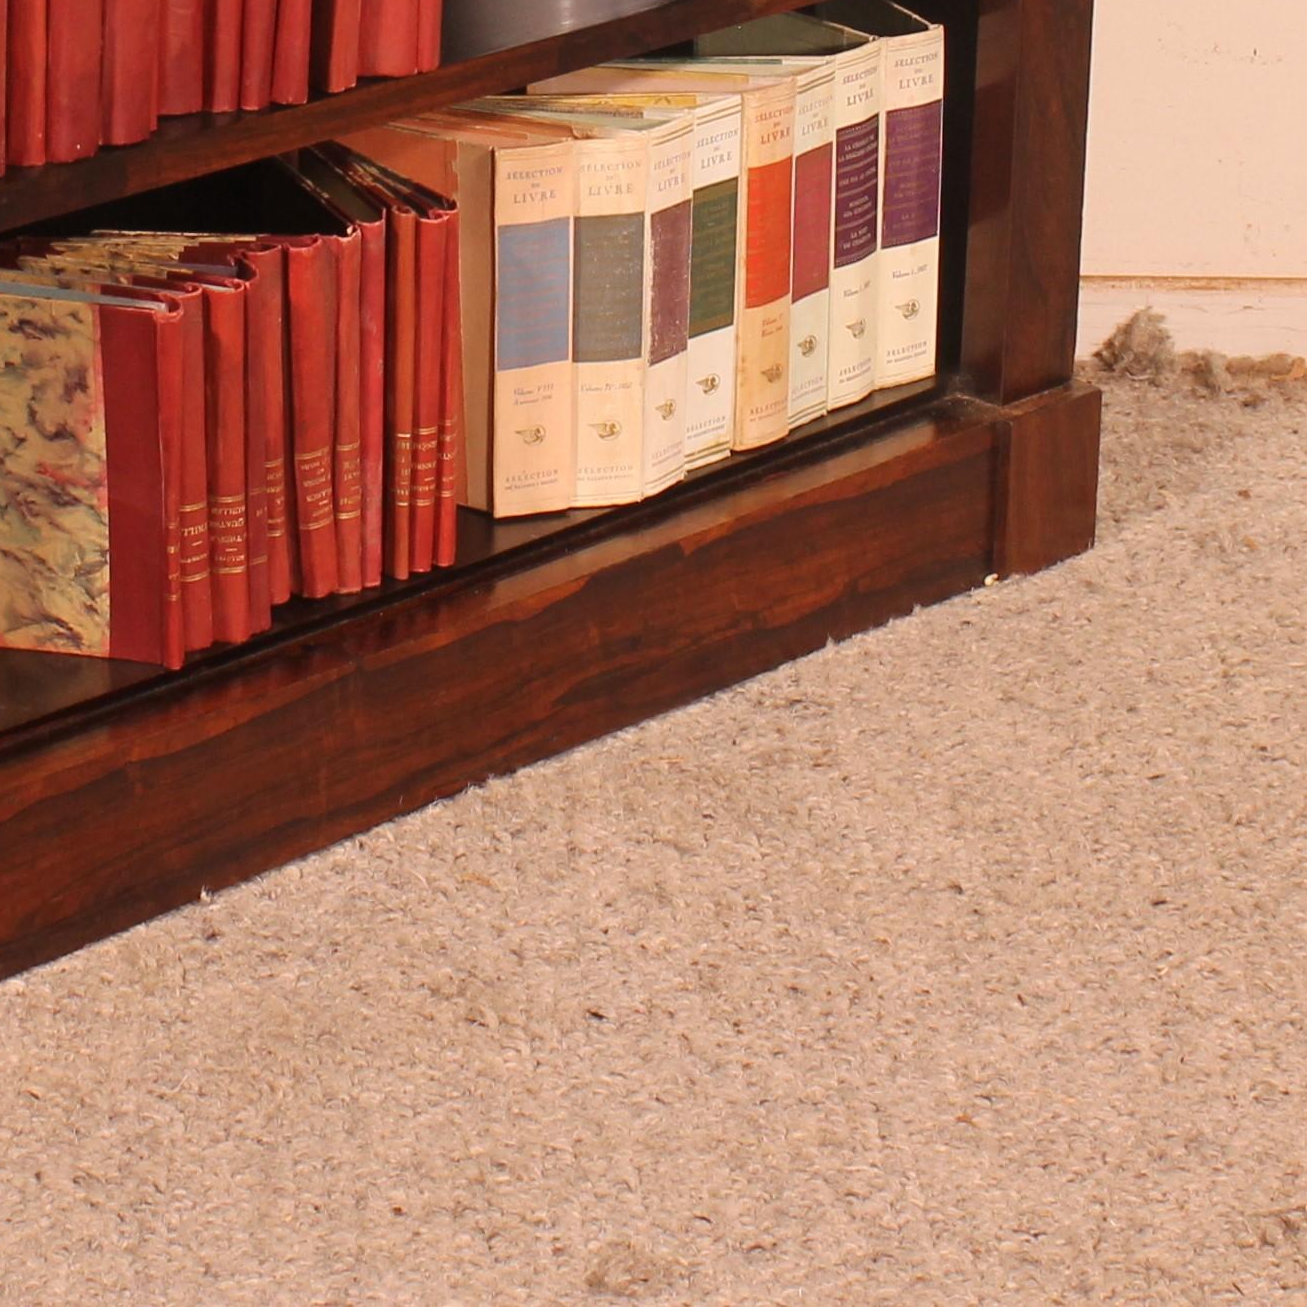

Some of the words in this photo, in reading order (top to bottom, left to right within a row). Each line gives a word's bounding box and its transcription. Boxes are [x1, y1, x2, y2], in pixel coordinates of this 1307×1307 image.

[893, 52, 939, 69] SÉLECTION
[898, 74, 935, 90] LIVRE
[846, 88, 874, 107] LIVRE
[759, 126, 791, 145] LIVRE
[801, 117, 829, 136] LIVRE
[695, 127, 740, 149] SÉLECTION
[700, 151, 733, 170] LIVRE
[505, 165, 565, 180] SÉLECTION
[587, 183, 634, 196] LIVRE
[657, 173, 686, 192] LIVRE
[512, 189, 557, 204] LIVRE
